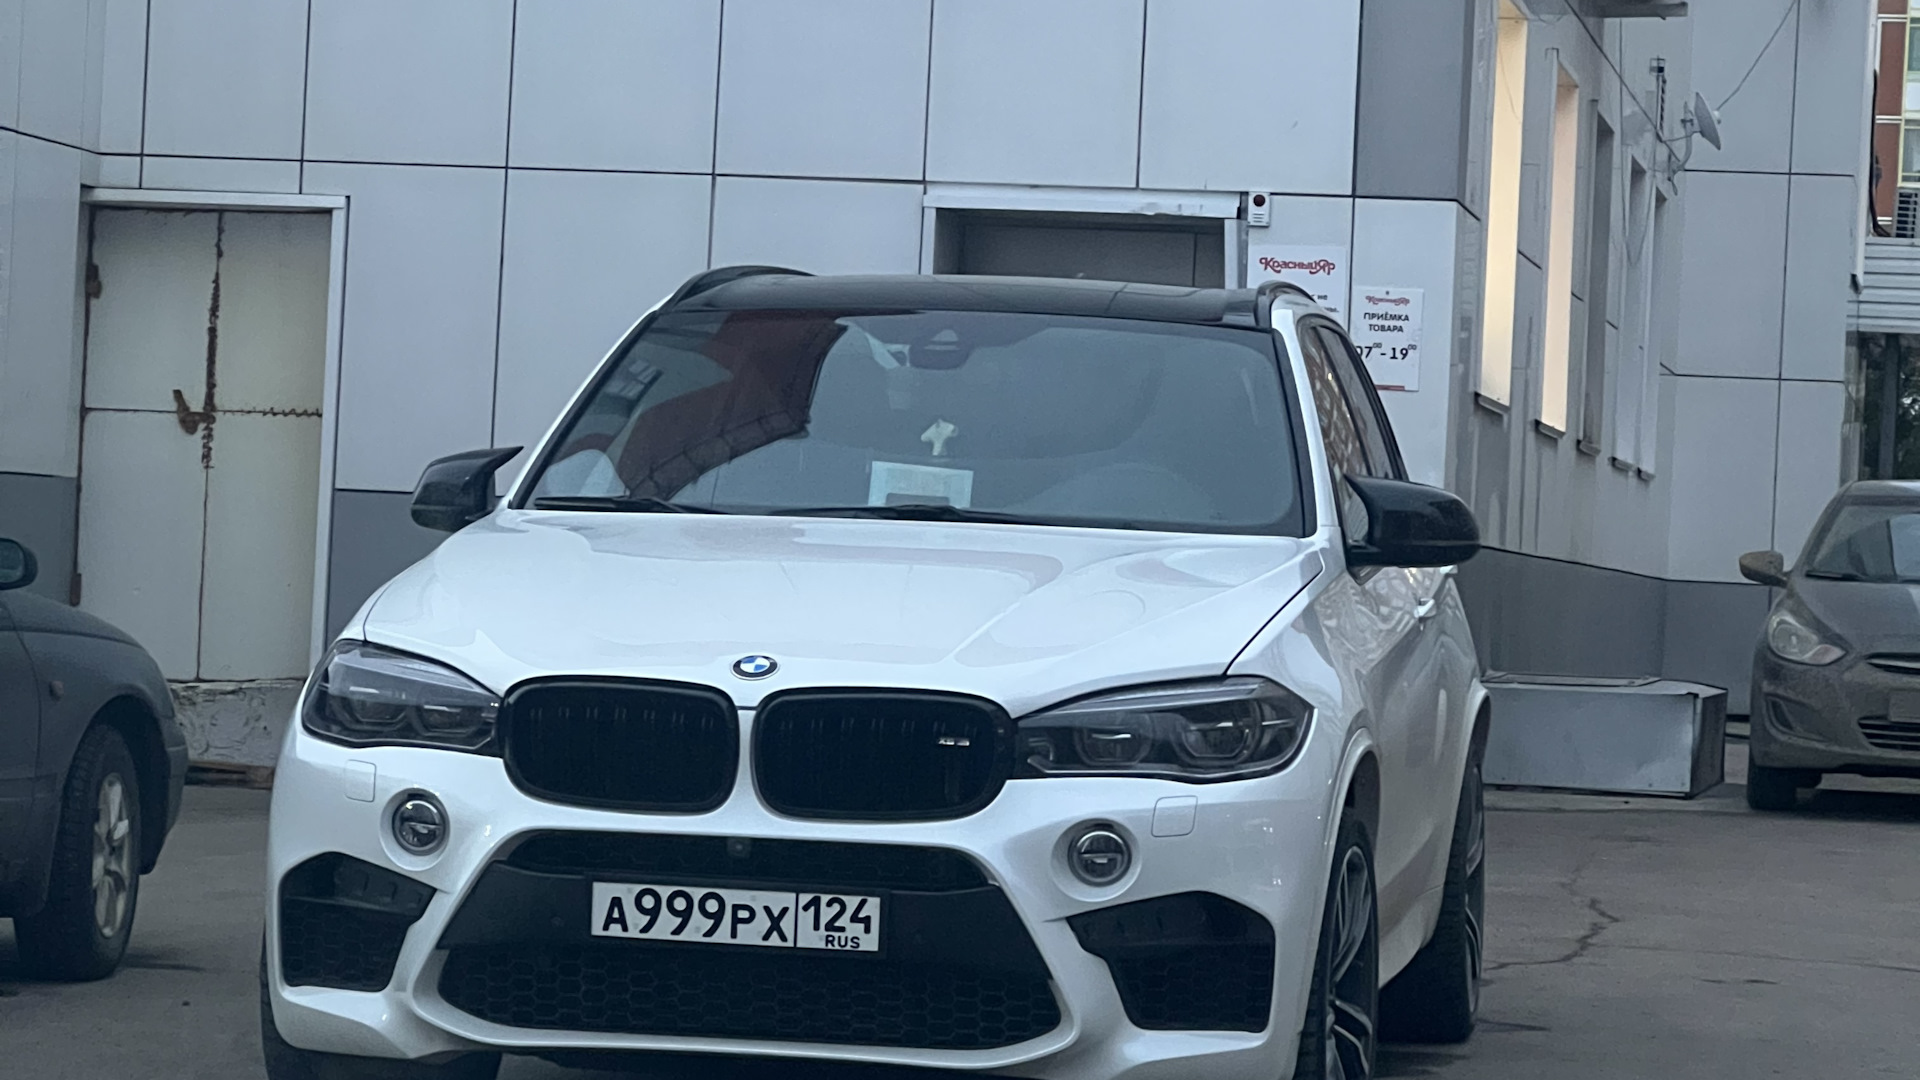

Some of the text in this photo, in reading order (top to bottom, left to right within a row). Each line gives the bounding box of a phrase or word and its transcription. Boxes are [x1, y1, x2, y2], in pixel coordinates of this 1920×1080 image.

[1363, 311, 1410, 322] ПРИЁМКА
[1368, 324, 1404, 333] ТОВАРА
[602, 887, 872, 943] А999РХ 124
[825, 934, 861, 949] RUS
